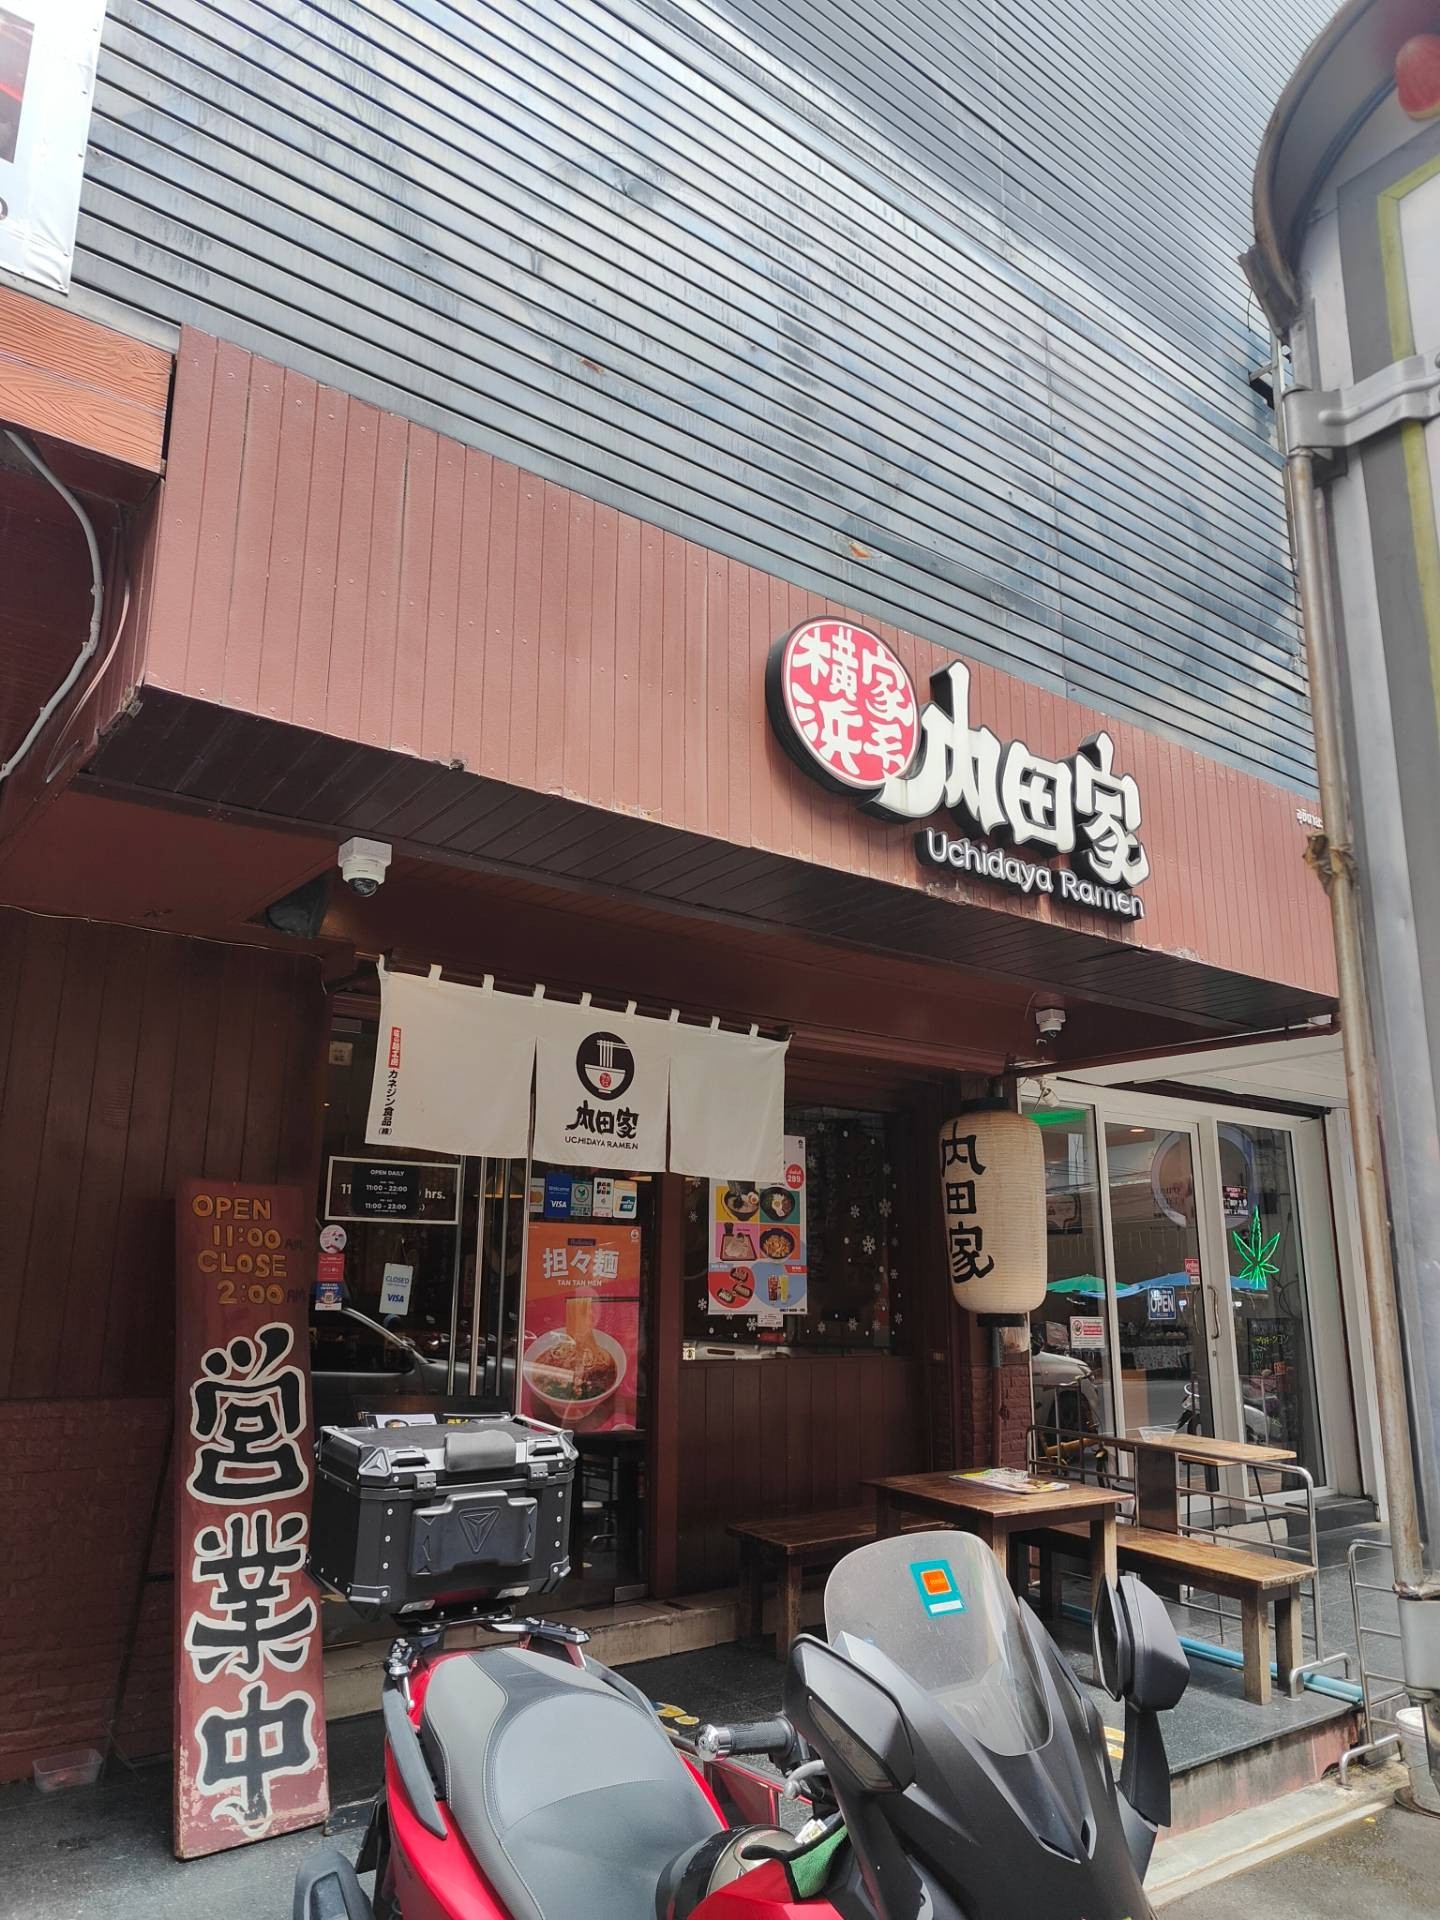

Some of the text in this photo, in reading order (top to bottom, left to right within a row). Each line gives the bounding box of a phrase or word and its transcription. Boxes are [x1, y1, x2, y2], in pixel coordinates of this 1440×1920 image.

[926, 827, 1145, 919] Uchidaya Ramen
[564, 1136, 639, 1150] UCHIDAYA RAMEN
[424, 1188, 446, 1200] hrs.
[551, 1200, 567, 1208] VISA
[942, 1121, 995, 1284] 内田家
[191, 1193, 272, 1220] OPEN
[212, 1223, 281, 1249] 11:00
[197, 1248, 288, 1278] CLOSE
[385, 1275, 409, 1285] CLOSED
[216, 1279, 285, 1305] 2:00
[387, 1293, 404, 1303] VISA
[1150, 1294, 1174, 1312] OPEN
